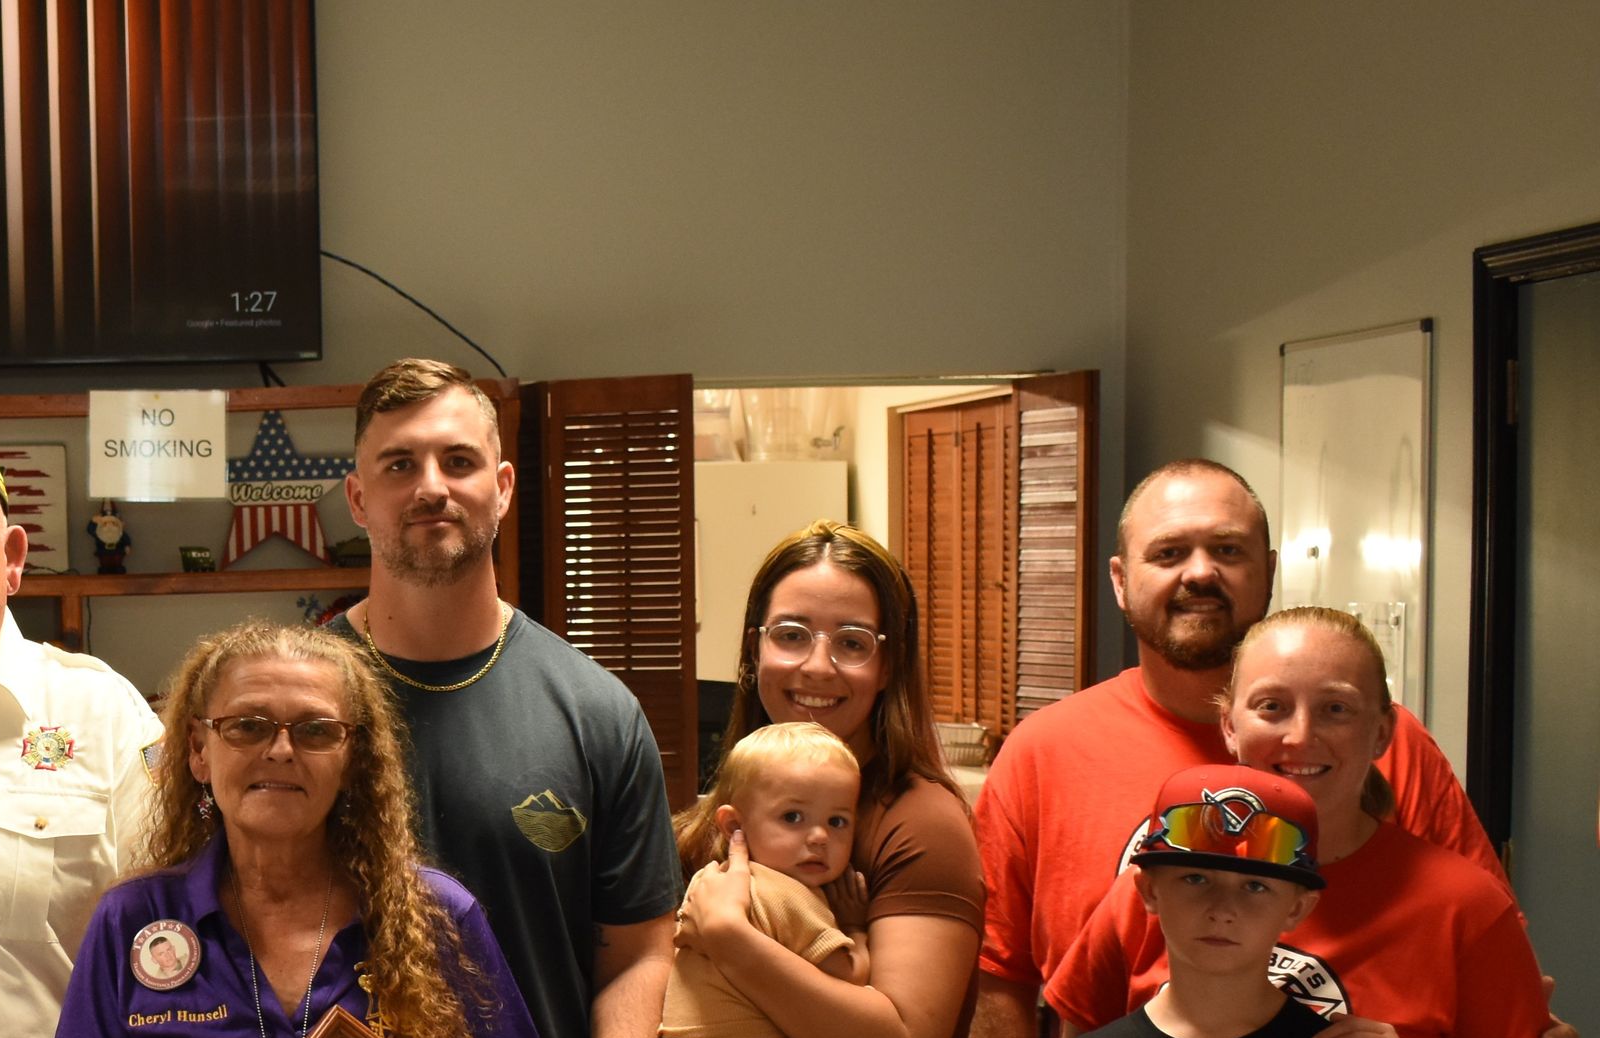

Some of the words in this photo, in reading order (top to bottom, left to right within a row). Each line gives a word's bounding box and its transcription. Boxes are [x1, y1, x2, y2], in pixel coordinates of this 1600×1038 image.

[231, 291, 278, 313] 1:27
[141, 408, 175, 427] NO
[104, 439, 213, 459] SMOKING
[231, 483, 324, 502] Welcome
[128, 1010, 172, 1027] Cheryl
[177, 1004, 229, 1022] Hunsell
